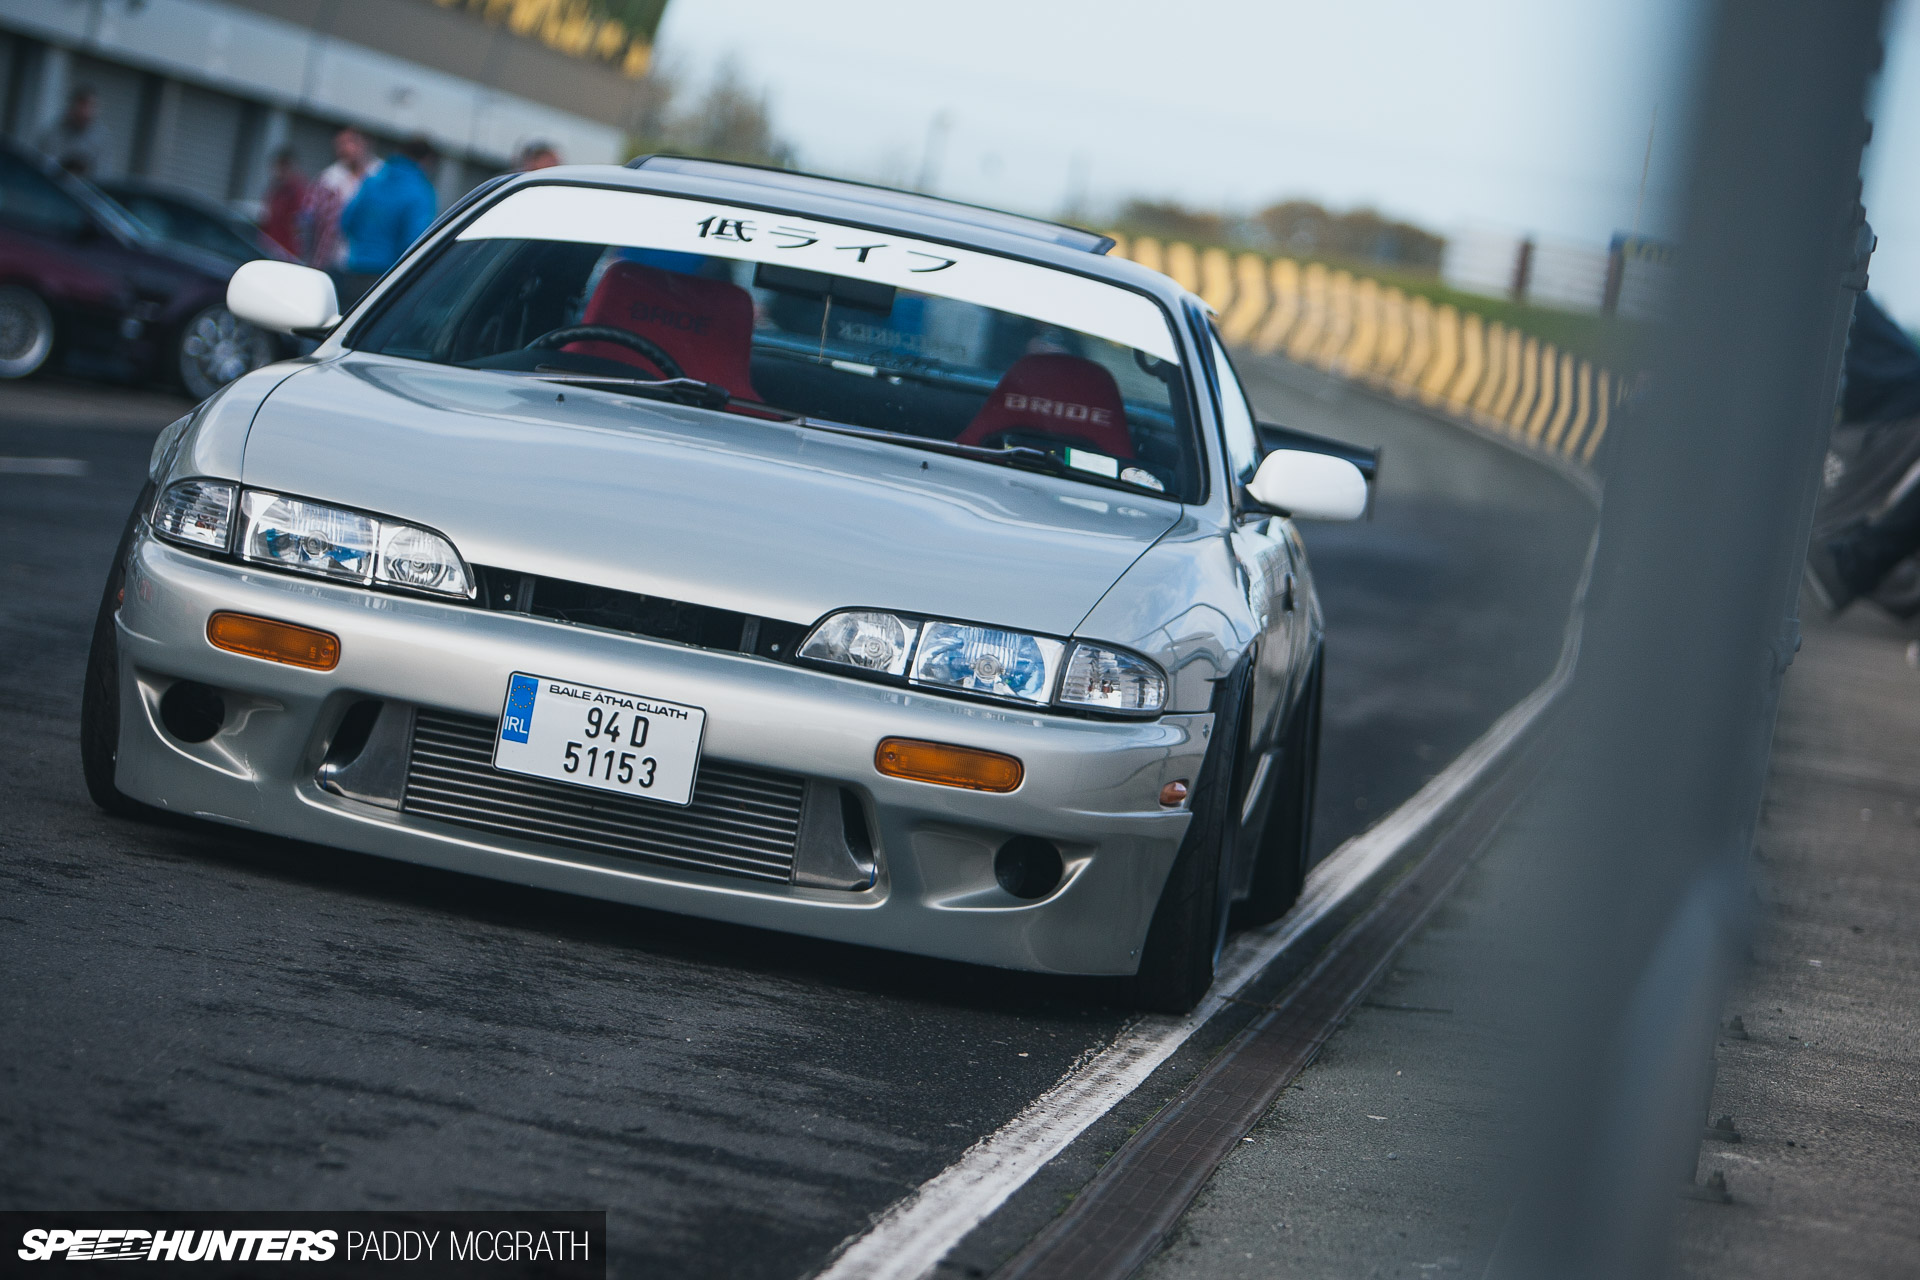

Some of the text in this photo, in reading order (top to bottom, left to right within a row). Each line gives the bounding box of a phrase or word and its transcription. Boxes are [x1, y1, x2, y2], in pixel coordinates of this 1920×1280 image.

[696, 215, 958, 273] 低ライフ
[629, 301, 713, 336] BRIDE
[1004, 393, 1112, 427] BRIDE
[549, 684, 592, 701] BAILE
[636, 702, 688, 720] CLIATH
[504, 715, 529, 734] IRL
[584, 707, 650, 748] 94 D
[563, 741, 658, 788] 51153
